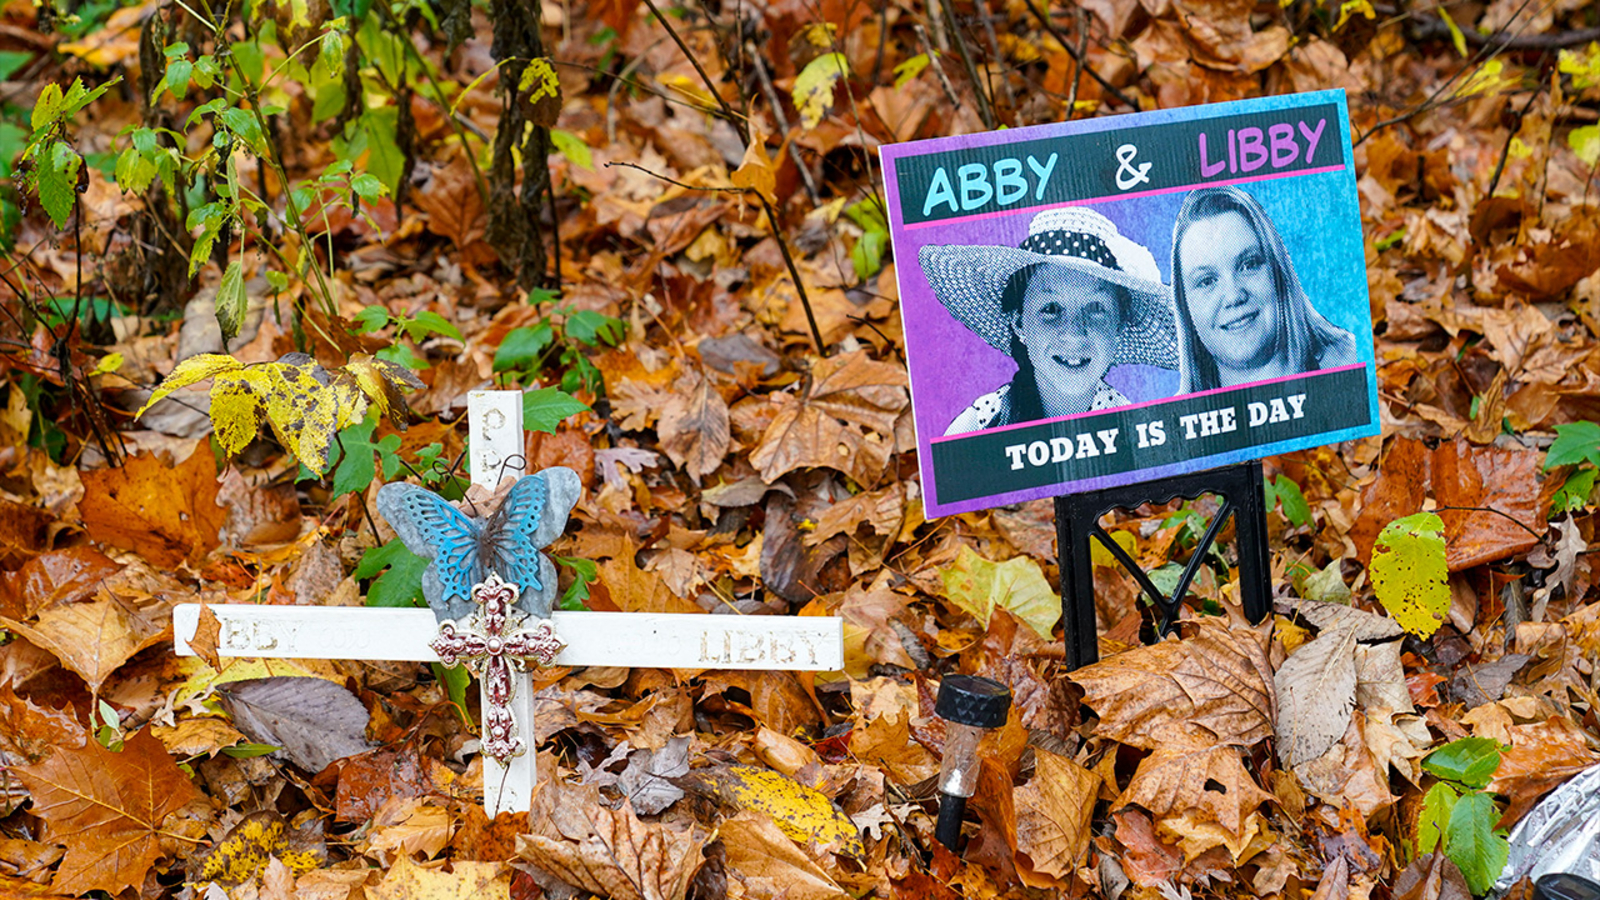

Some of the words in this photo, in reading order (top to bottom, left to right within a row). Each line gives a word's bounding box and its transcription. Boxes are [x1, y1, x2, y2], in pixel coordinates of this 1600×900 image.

[923, 153, 1059, 217] ABBY
[1115, 144, 1153, 191] &
[1198, 118, 1327, 178] LIBBY
[1004, 428, 1119, 471] TODAY
[1137, 419, 1167, 449] IS
[1179, 406, 1237, 440] THE
[1247, 393, 1307, 427] DAY
[222, 616, 303, 653] BBY
